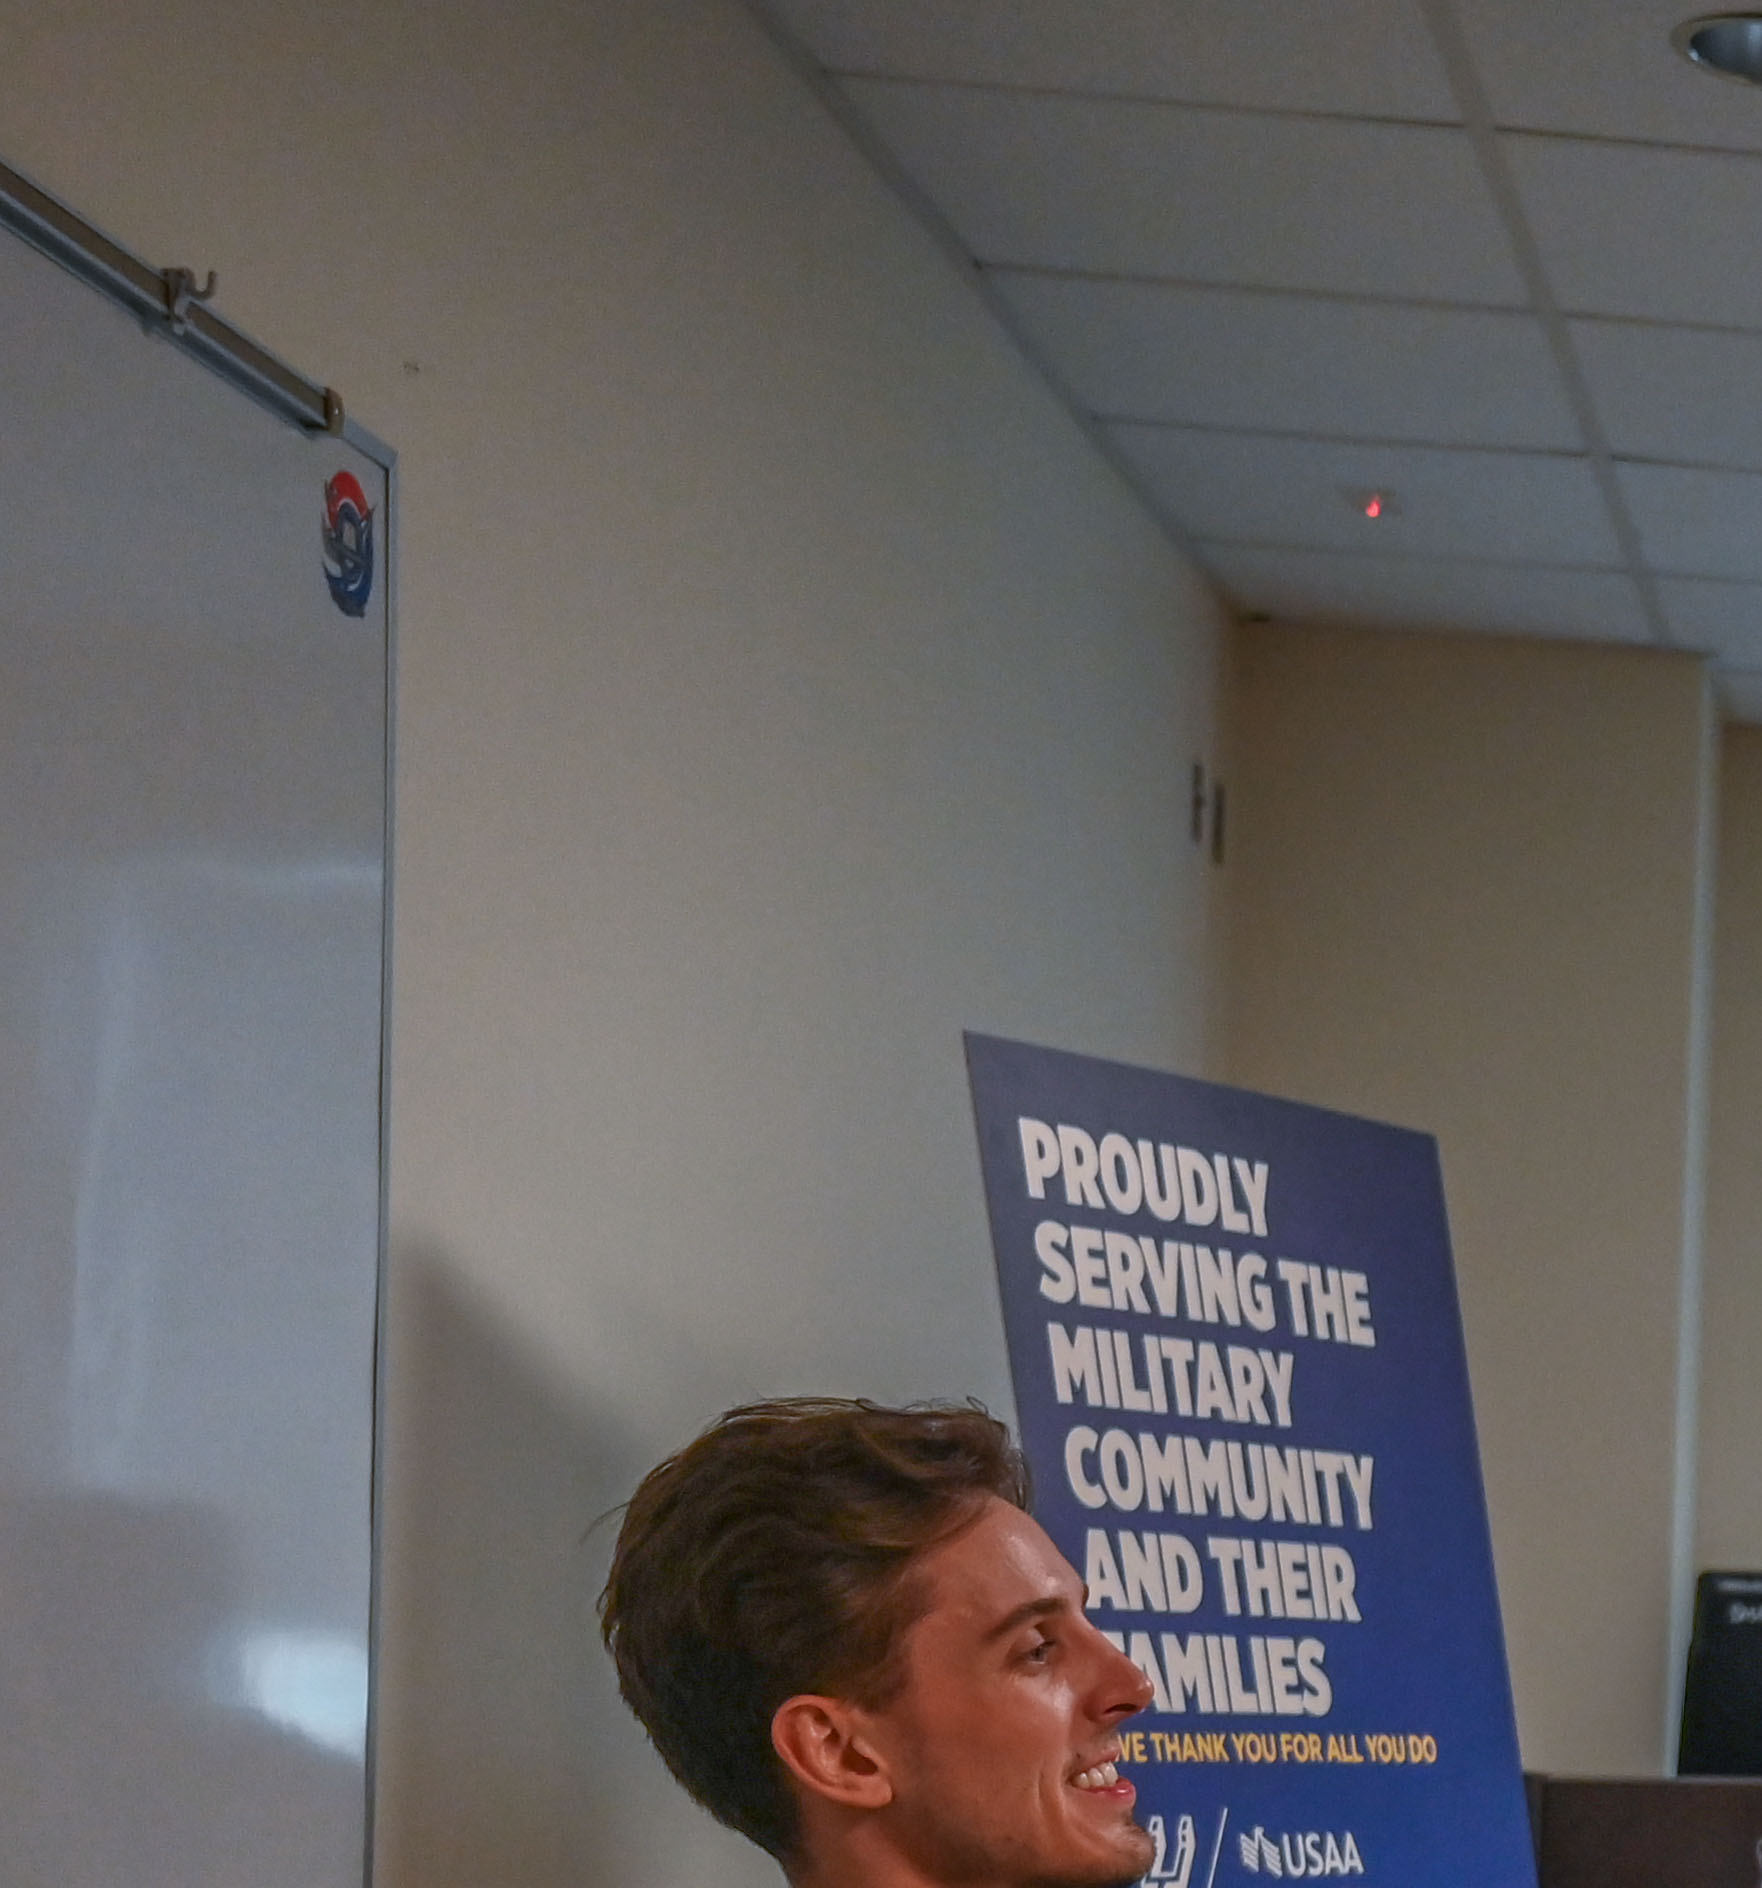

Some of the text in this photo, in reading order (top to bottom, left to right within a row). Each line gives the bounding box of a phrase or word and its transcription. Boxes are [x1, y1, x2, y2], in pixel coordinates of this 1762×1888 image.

[1018, 1116, 1269, 1237] PROUDLY
[1035, 1221, 1376, 1347] SERVING THE
[1048, 1323, 1293, 1427] MILITARY
[1065, 1426, 1374, 1531] COMMUNITY
[1085, 1529, 1362, 1623] AND THEIR
[1101, 1630, 1333, 1717] AMILIES
[1150, 1731, 1230, 1763] THANK
[1232, 1733, 1277, 1763] YOU
[1280, 1733, 1324, 1763] FOR
[1327, 1734, 1364, 1763] ALL
[1365, 1735, 1406, 1764] YOU
[1408, 1735, 1438, 1764] DO
[1282, 1831, 1365, 1877] USAA
